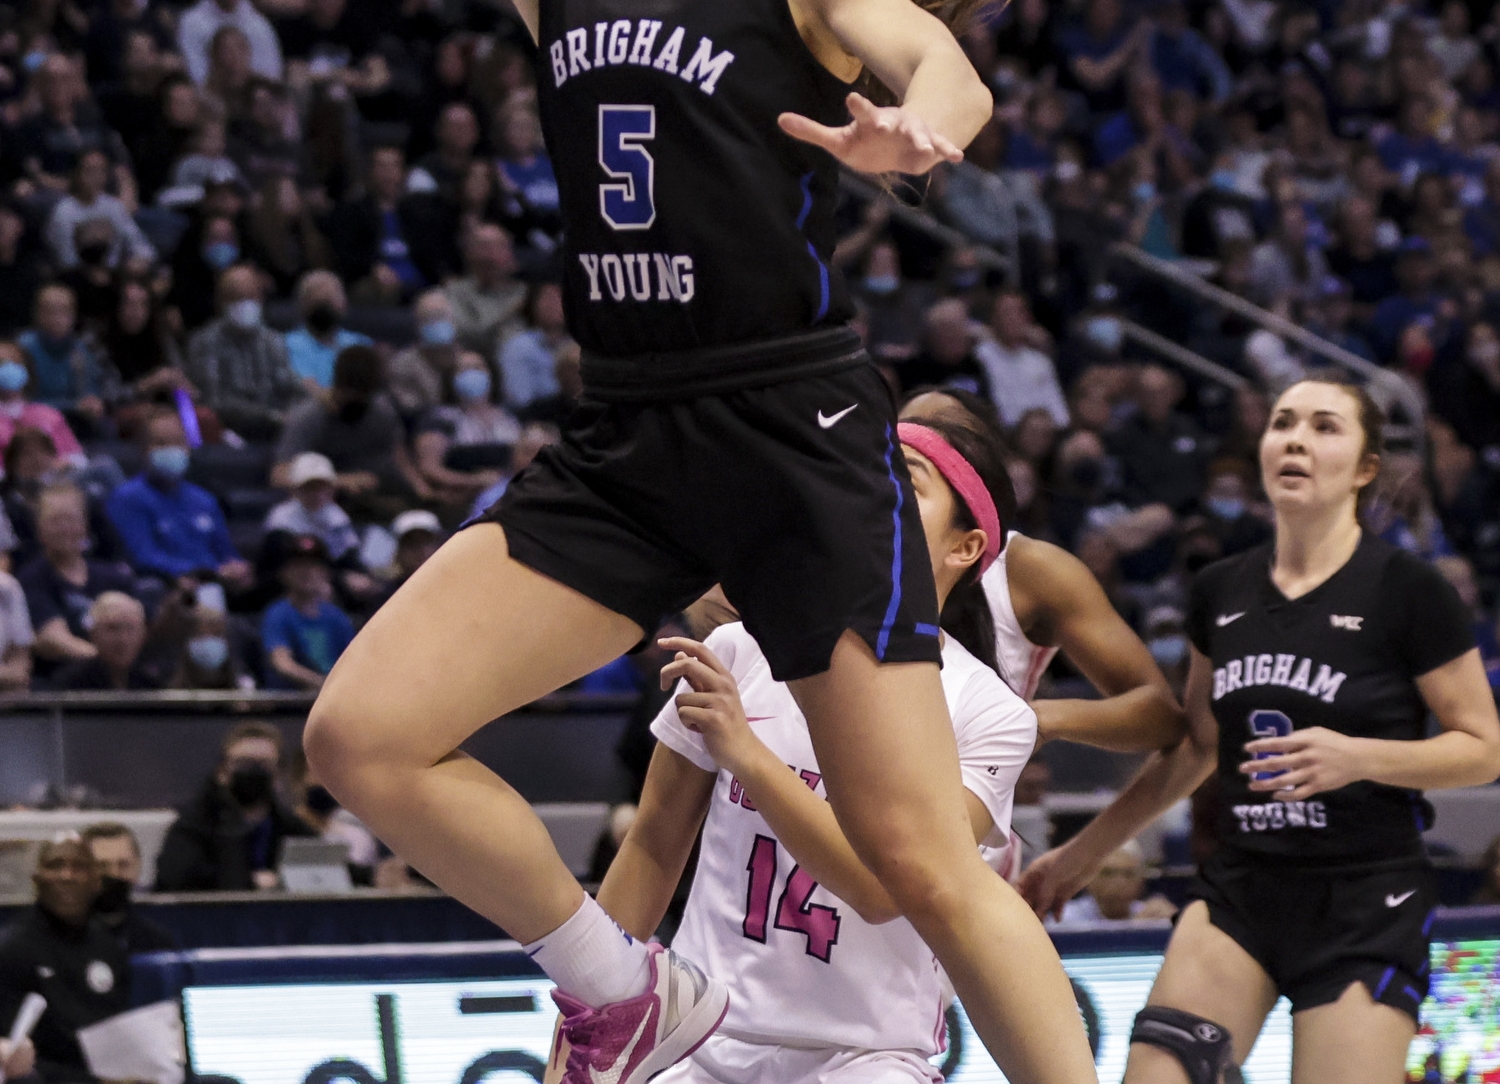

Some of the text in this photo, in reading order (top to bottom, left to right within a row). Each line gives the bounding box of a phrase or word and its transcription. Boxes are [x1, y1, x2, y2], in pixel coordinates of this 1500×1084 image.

[550, 19, 735, 95] BRIGHAM
[599, 104, 655, 230] 5
[579, 253, 695, 303] YOUNG
[1213, 653, 1347, 703] BRIGHAM
[1232, 801, 1328, 832] YOUNG
[743, 833, 841, 964] 14
